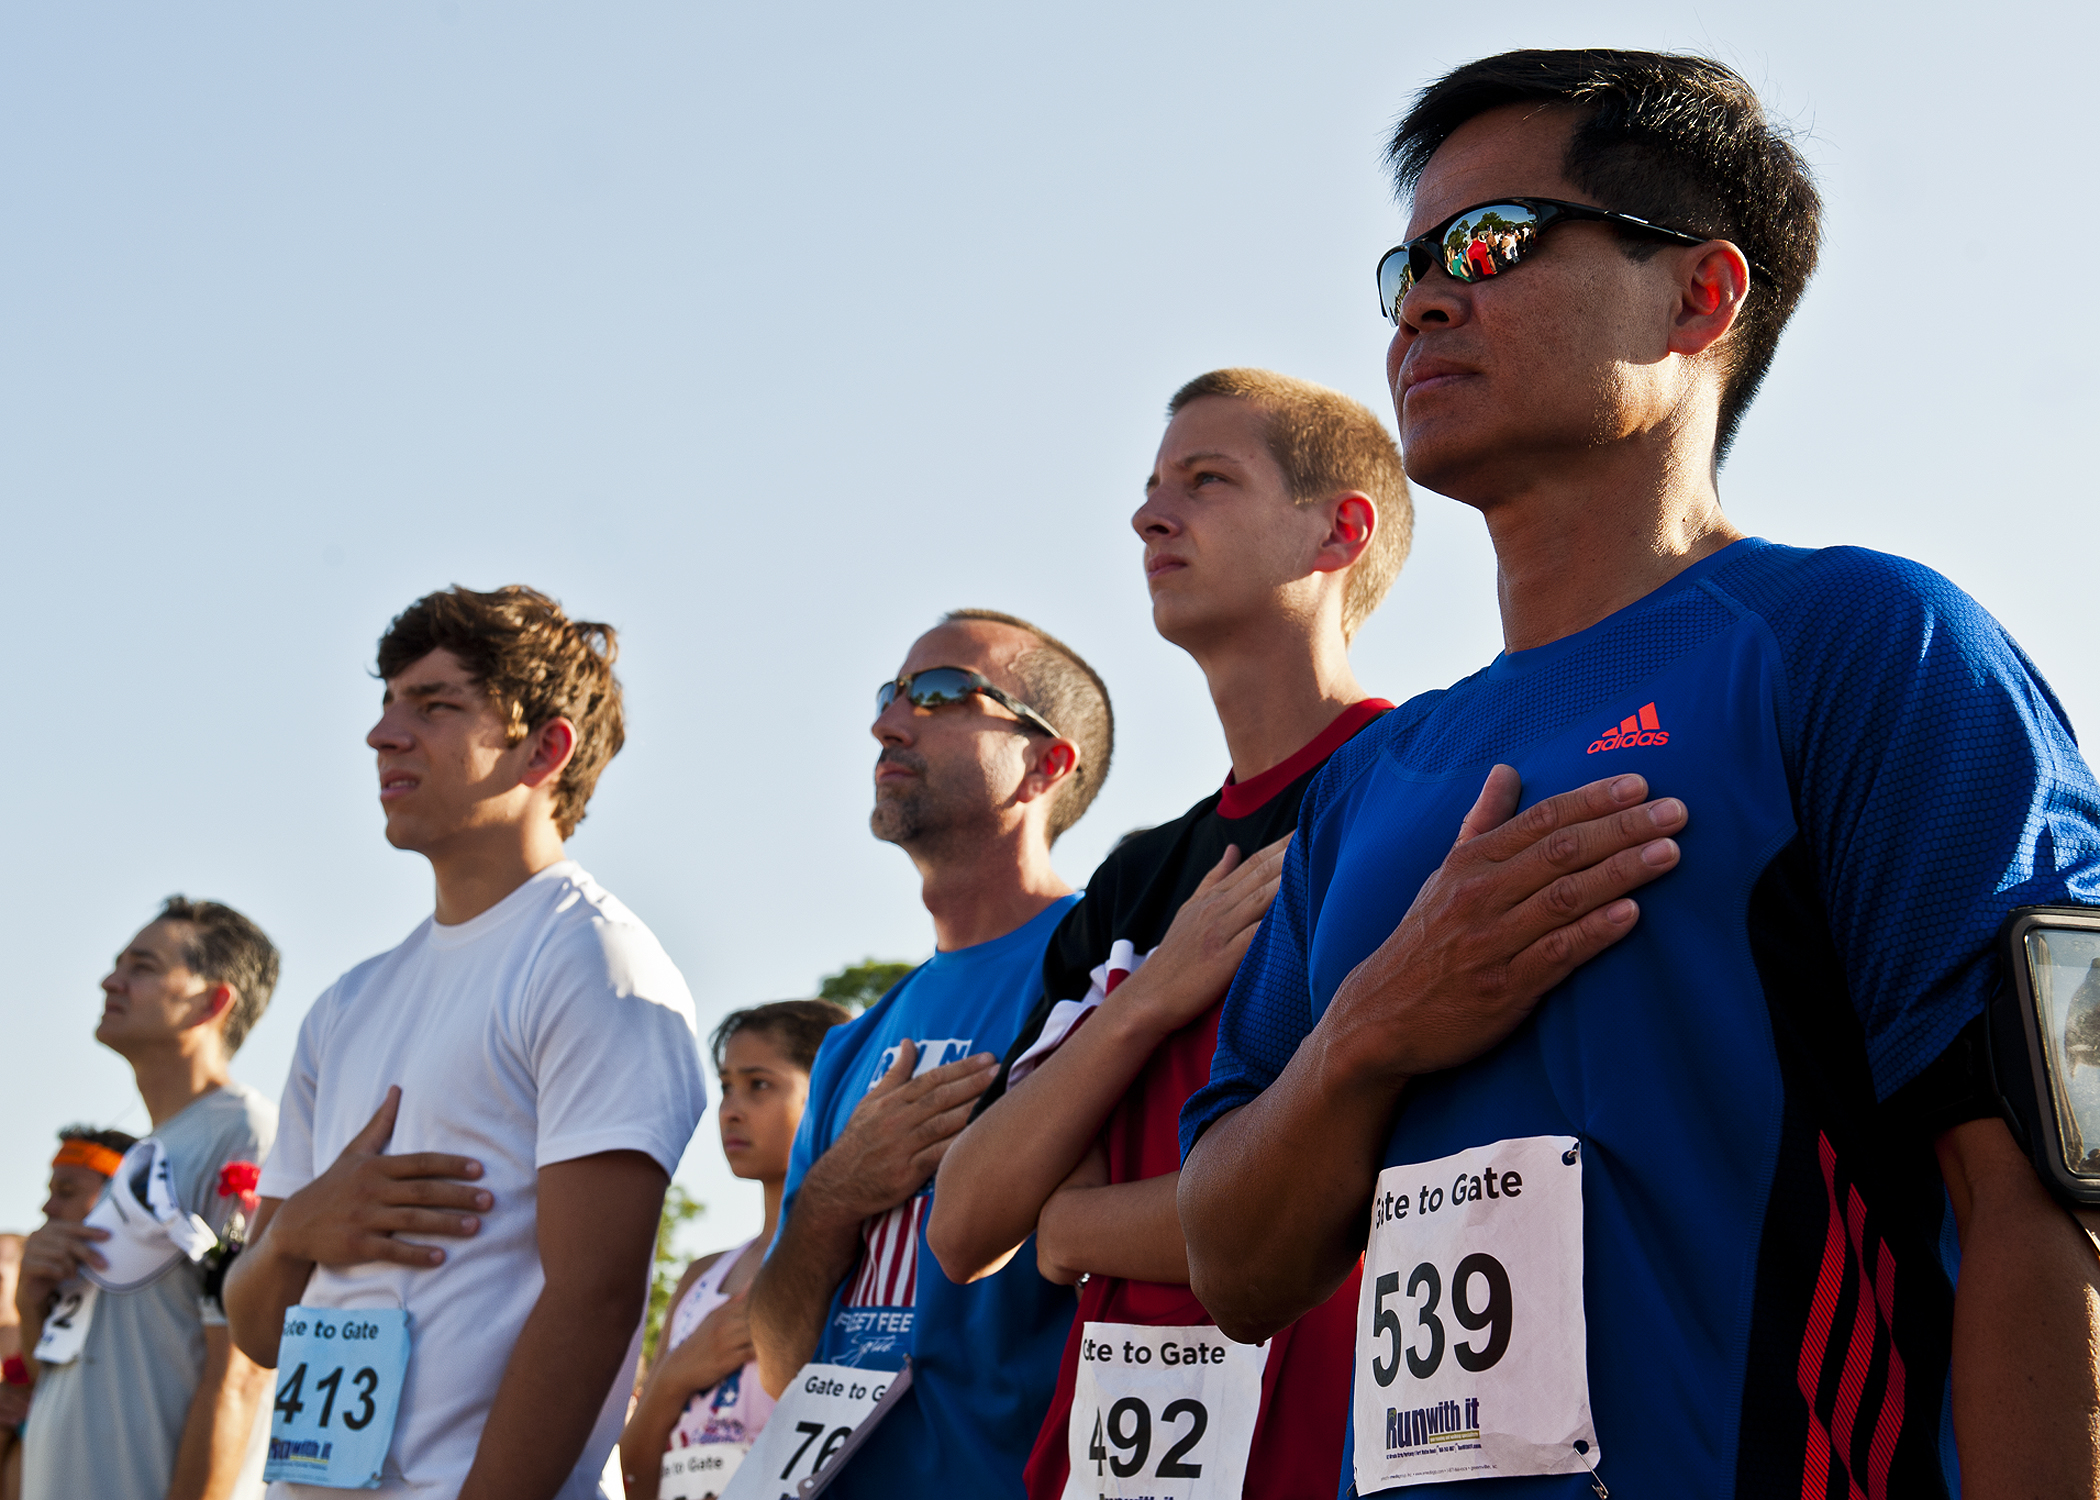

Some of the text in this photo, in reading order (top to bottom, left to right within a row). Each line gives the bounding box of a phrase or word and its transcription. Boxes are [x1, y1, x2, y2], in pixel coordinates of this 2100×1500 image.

[1587, 730, 1670, 754] adidas
[1419, 1185, 1444, 1215] to
[1451, 1167, 1523, 1206] Gate
[313, 1319, 337, 1340] to
[341, 1320, 380, 1341] Gate
[877, 1312, 915, 1333] FEE
[1372, 1252, 1513, 1388] 539
[1082, 1338, 1226, 1366] te to Gate
[274, 1361, 379, 1431] 413
[804, 1375, 844, 1398] Gate
[848, 1382, 867, 1400] to
[1088, 1396, 1209, 1479] 492
